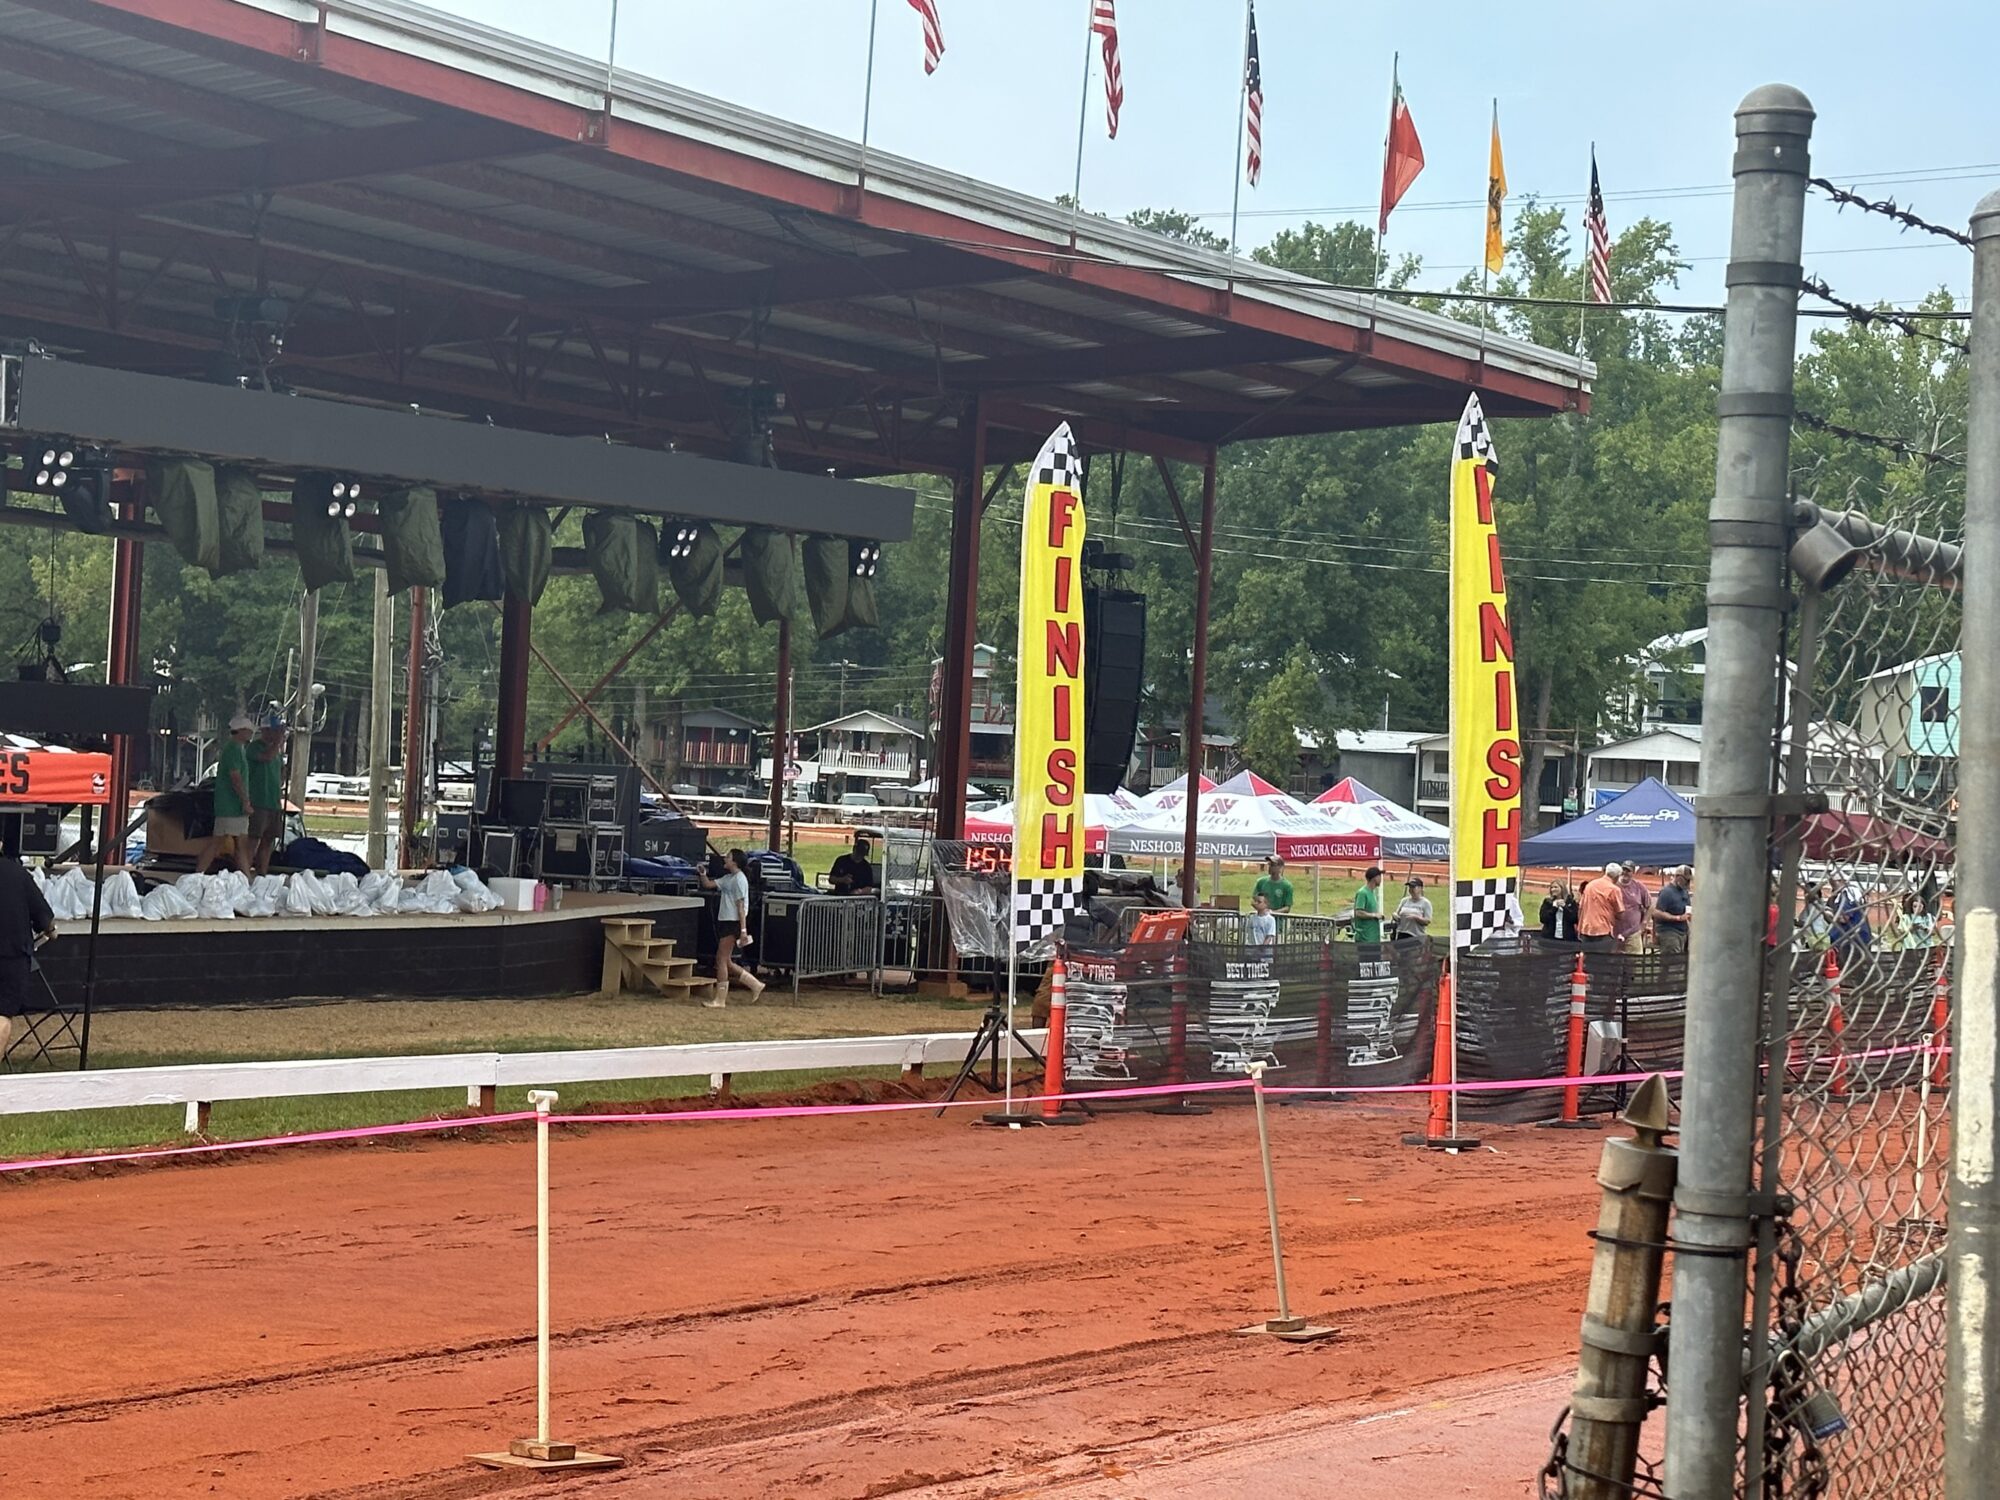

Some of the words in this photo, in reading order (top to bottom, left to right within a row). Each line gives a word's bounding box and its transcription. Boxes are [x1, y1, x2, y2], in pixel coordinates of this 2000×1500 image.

[1040, 490, 1081, 870] FINISH
[644, 840, 659, 852] SM
[663, 841, 670, 853] 7
[1290, 844, 1330, 858] NESHOBA
[1330, 843, 1368, 856] GENERAL
[1394, 843, 1431, 855] NESHOBA
[1226, 962, 1245, 979] BEST
[1246, 962, 1270, 979] TIMES
